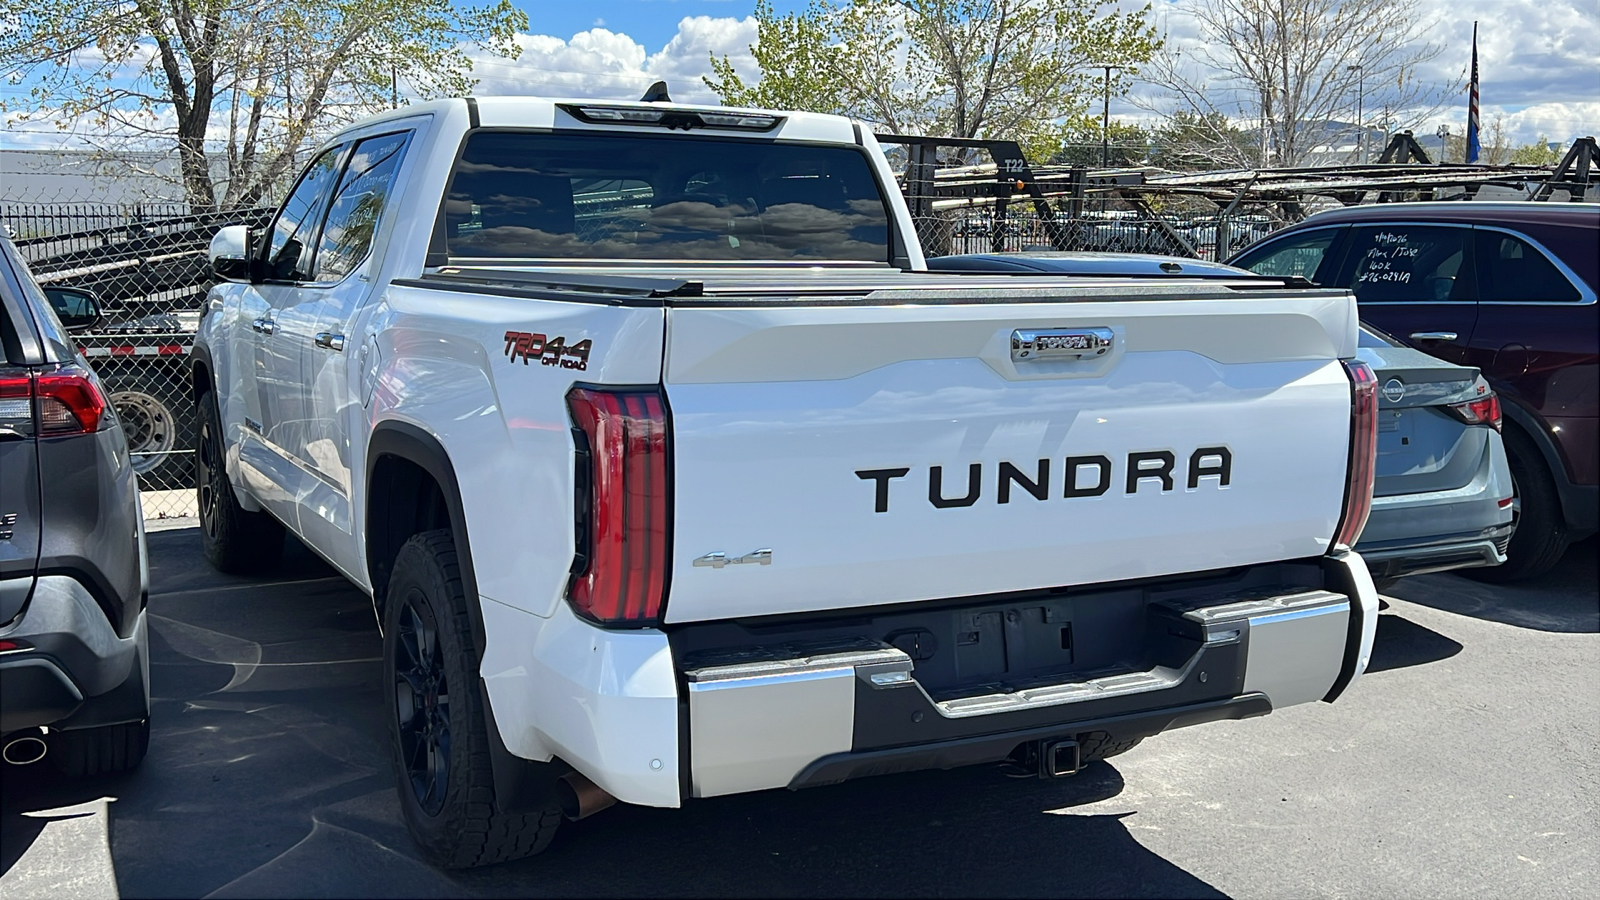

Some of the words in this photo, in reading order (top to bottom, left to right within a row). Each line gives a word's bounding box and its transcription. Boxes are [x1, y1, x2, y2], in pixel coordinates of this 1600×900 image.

[1004, 159, 1024, 173] T22
[1039, 336, 1088, 349] TOYOTA
[541, 356, 560, 367] OFF
[560, 359, 587, 371] ROAD
[854, 445, 1232, 514] TUNDRA
